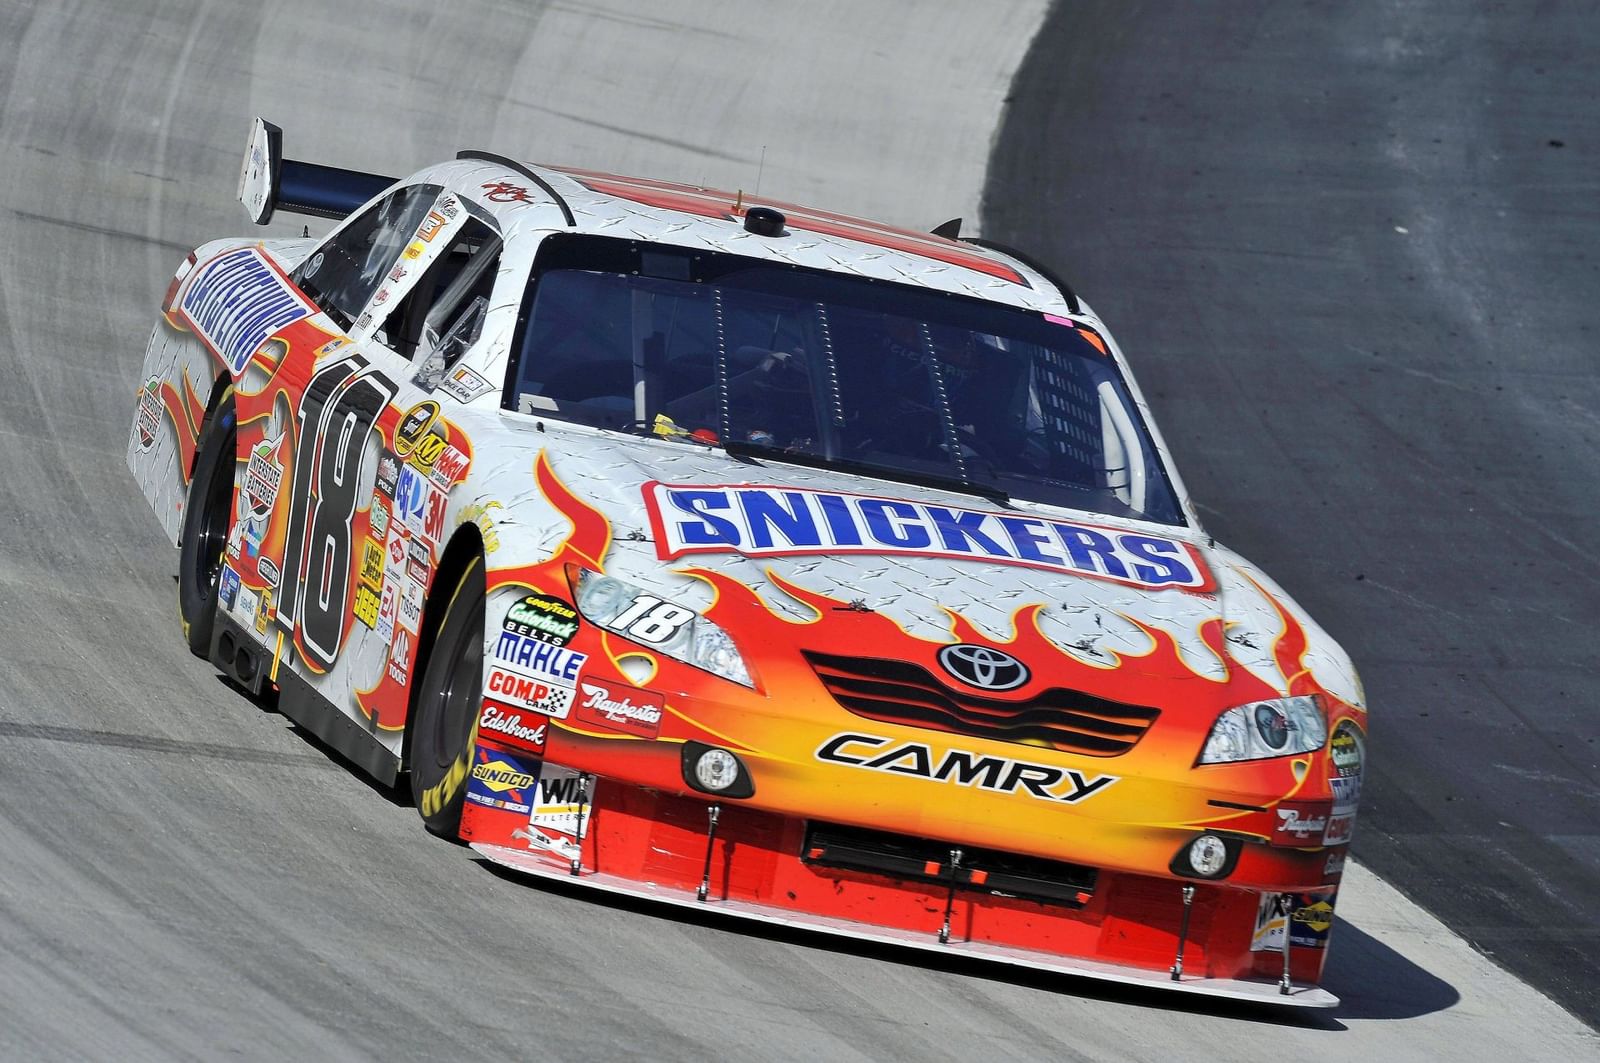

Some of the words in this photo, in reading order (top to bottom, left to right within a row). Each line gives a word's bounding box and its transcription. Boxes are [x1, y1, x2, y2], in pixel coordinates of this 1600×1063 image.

[456, 387, 471, 400] CAR
[249, 453, 281, 489] INTERSTATE
[377, 479, 393, 495] POLE
[246, 475, 276, 506] BATTERIES
[274, 354, 399, 673] 18
[425, 489, 449, 543] 3M
[666, 489, 1194, 584] SNICKERS
[401, 594, 420, 624] TISSOT
[507, 602, 579, 640] Gatorback
[607, 595, 697, 644] 18
[505, 621, 564, 647] BELTS
[495, 631, 585, 681] MAHLE
[388, 663, 407, 687] TOOLS
[488, 671, 549, 702] COMP
[525, 699, 558, 713] CAMS
[581, 683, 663, 724] Raybestos
[480, 706, 546, 745] Edelbrock
[473, 766, 532, 788] SUNOCO
[816, 733, 1118, 803] CAMRY
